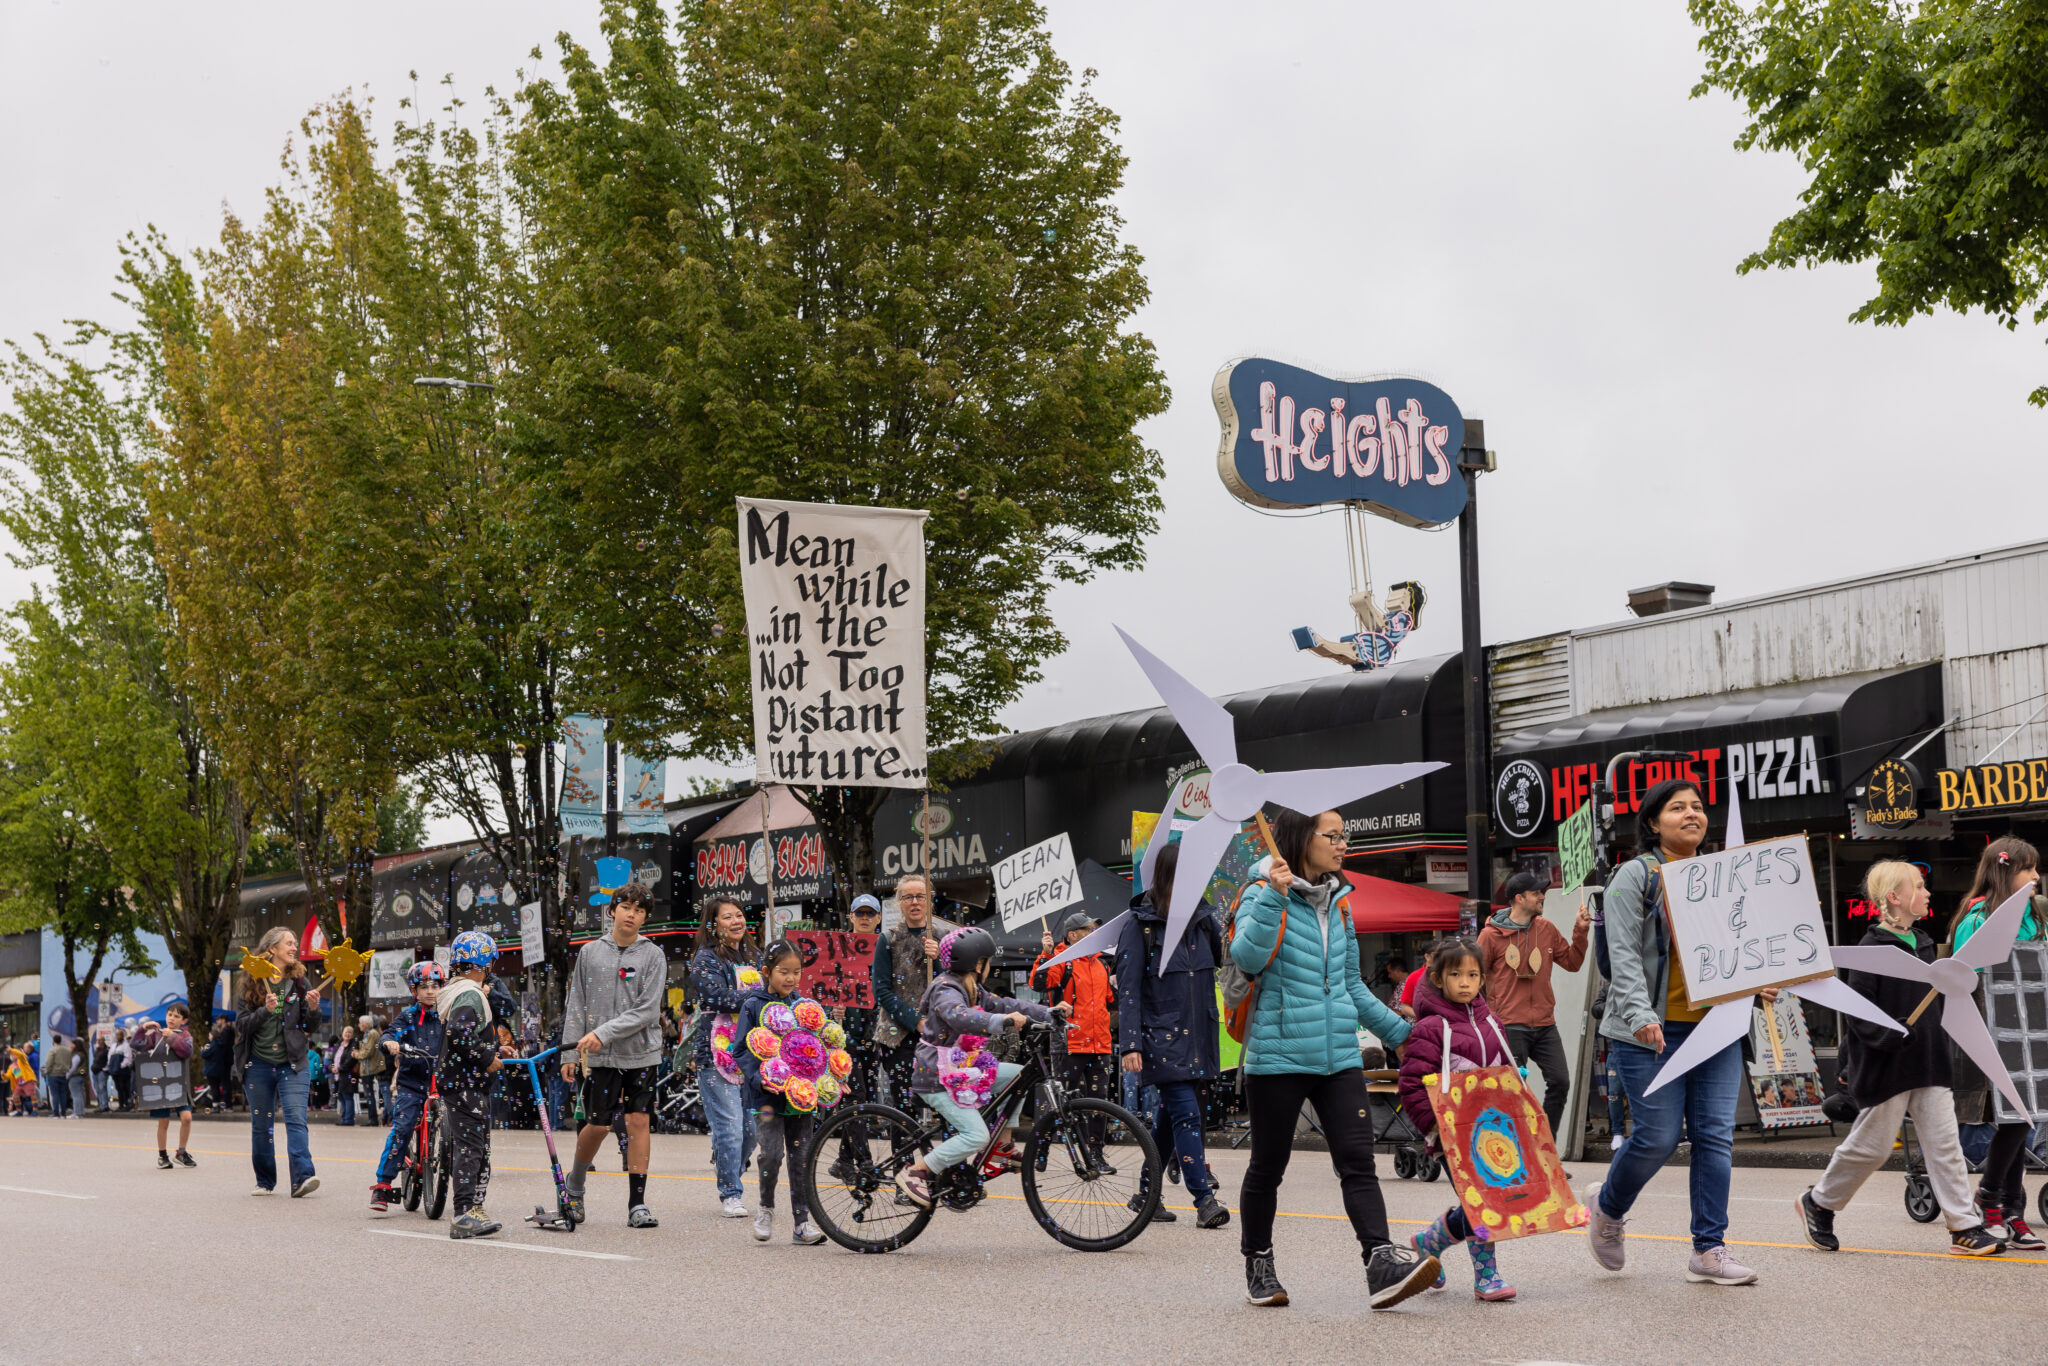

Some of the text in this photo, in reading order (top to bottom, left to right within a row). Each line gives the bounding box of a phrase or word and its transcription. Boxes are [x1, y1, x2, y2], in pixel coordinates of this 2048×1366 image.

[747, 506, 855, 567] Mean
[793, 563, 911, 608] while
[815, 600, 888, 647] the
[760, 648, 904, 692] Not Too
[768, 688, 905, 735] Distant
[1500, 765, 1540, 791] HELLCRUST
[1342, 812, 1422, 833] ARKING AT REAR
[1866, 808, 1893, 825] Fady's
[1894, 806, 1918, 821] Fades
[640, 868, 660, 880] MASTRO
[697, 840, 746, 889] OSAKA
[777, 832, 826, 879] SUSHI
[882, 833, 988, 875] CUCINA
[998, 837, 1064, 890] CLEAN
[1680, 847, 1801, 902] BIKES
[1002, 868, 1075, 922] ENERGY
[1728, 896, 1748, 938] &
[1694, 923, 1818, 984] BUSES
